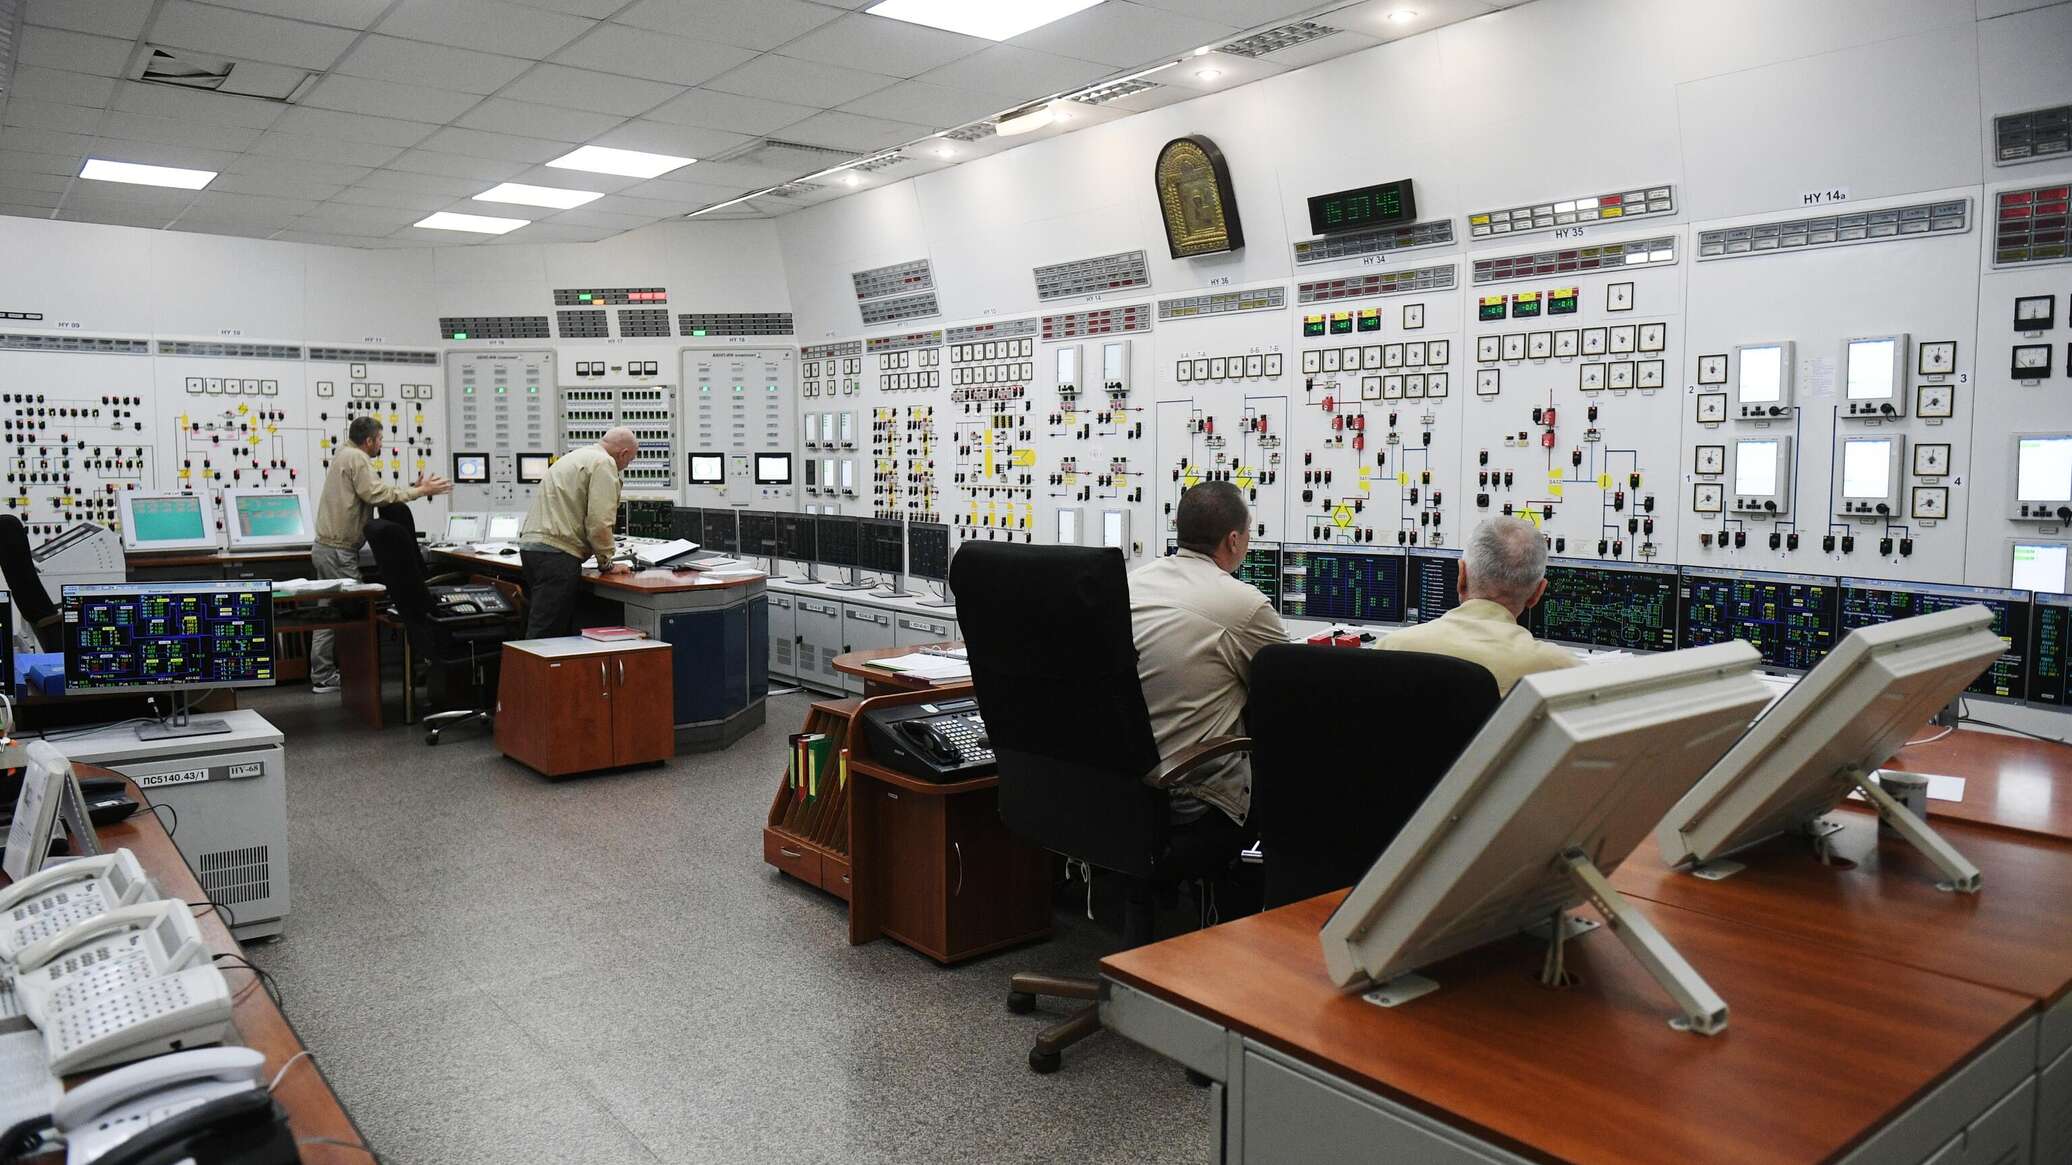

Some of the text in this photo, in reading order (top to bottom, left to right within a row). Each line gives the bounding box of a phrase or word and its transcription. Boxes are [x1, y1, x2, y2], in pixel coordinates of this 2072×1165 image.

[1804, 190, 1846, 204] HY 14a
[1555, 228, 1584, 239] HY 35
[1376, 256, 1386, 264] 34
[1960, 373, 1967, 383] 3
[1689, 385, 1694, 394] 2
[1686, 474, 1691, 482] 1
[1954, 476, 1962, 486] 4
[143, 771, 204, 785] ПС5140.43/1
